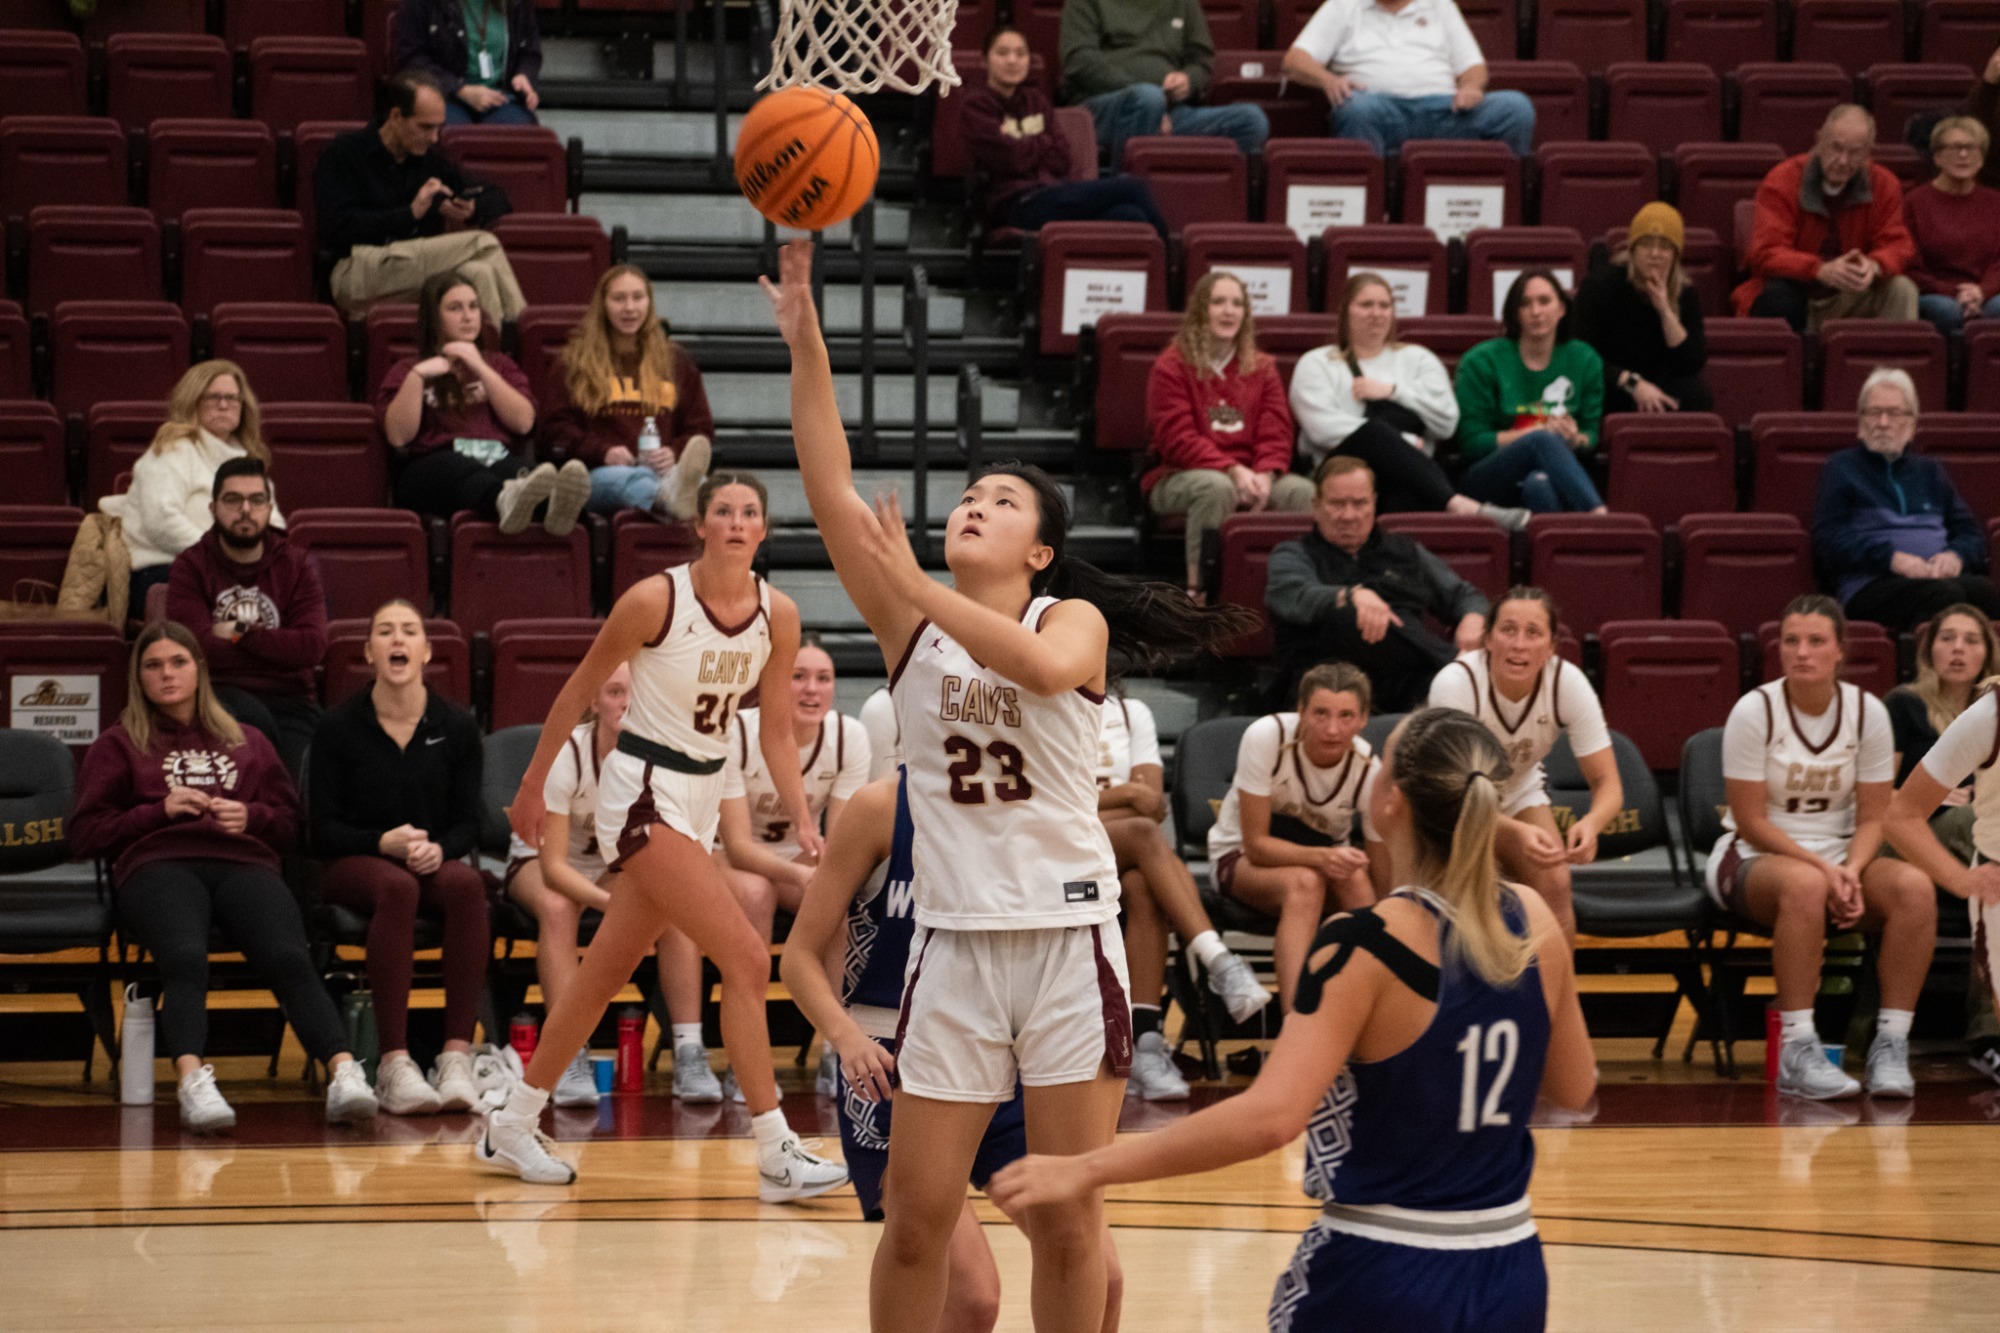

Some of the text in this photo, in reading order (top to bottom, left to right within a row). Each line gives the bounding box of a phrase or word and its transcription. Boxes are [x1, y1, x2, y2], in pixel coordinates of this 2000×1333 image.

[698, 650, 752, 684] CAVS
[940, 675, 1021, 727] CAVS
[33, 716, 76, 725] RESERVED
[59, 730, 93, 740] TRAINER
[943, 735, 1032, 804] 23
[1786, 762, 1841, 791] CAVS
[0, 817, 64, 846] LSH
[1457, 1019, 1519, 1132] 12
